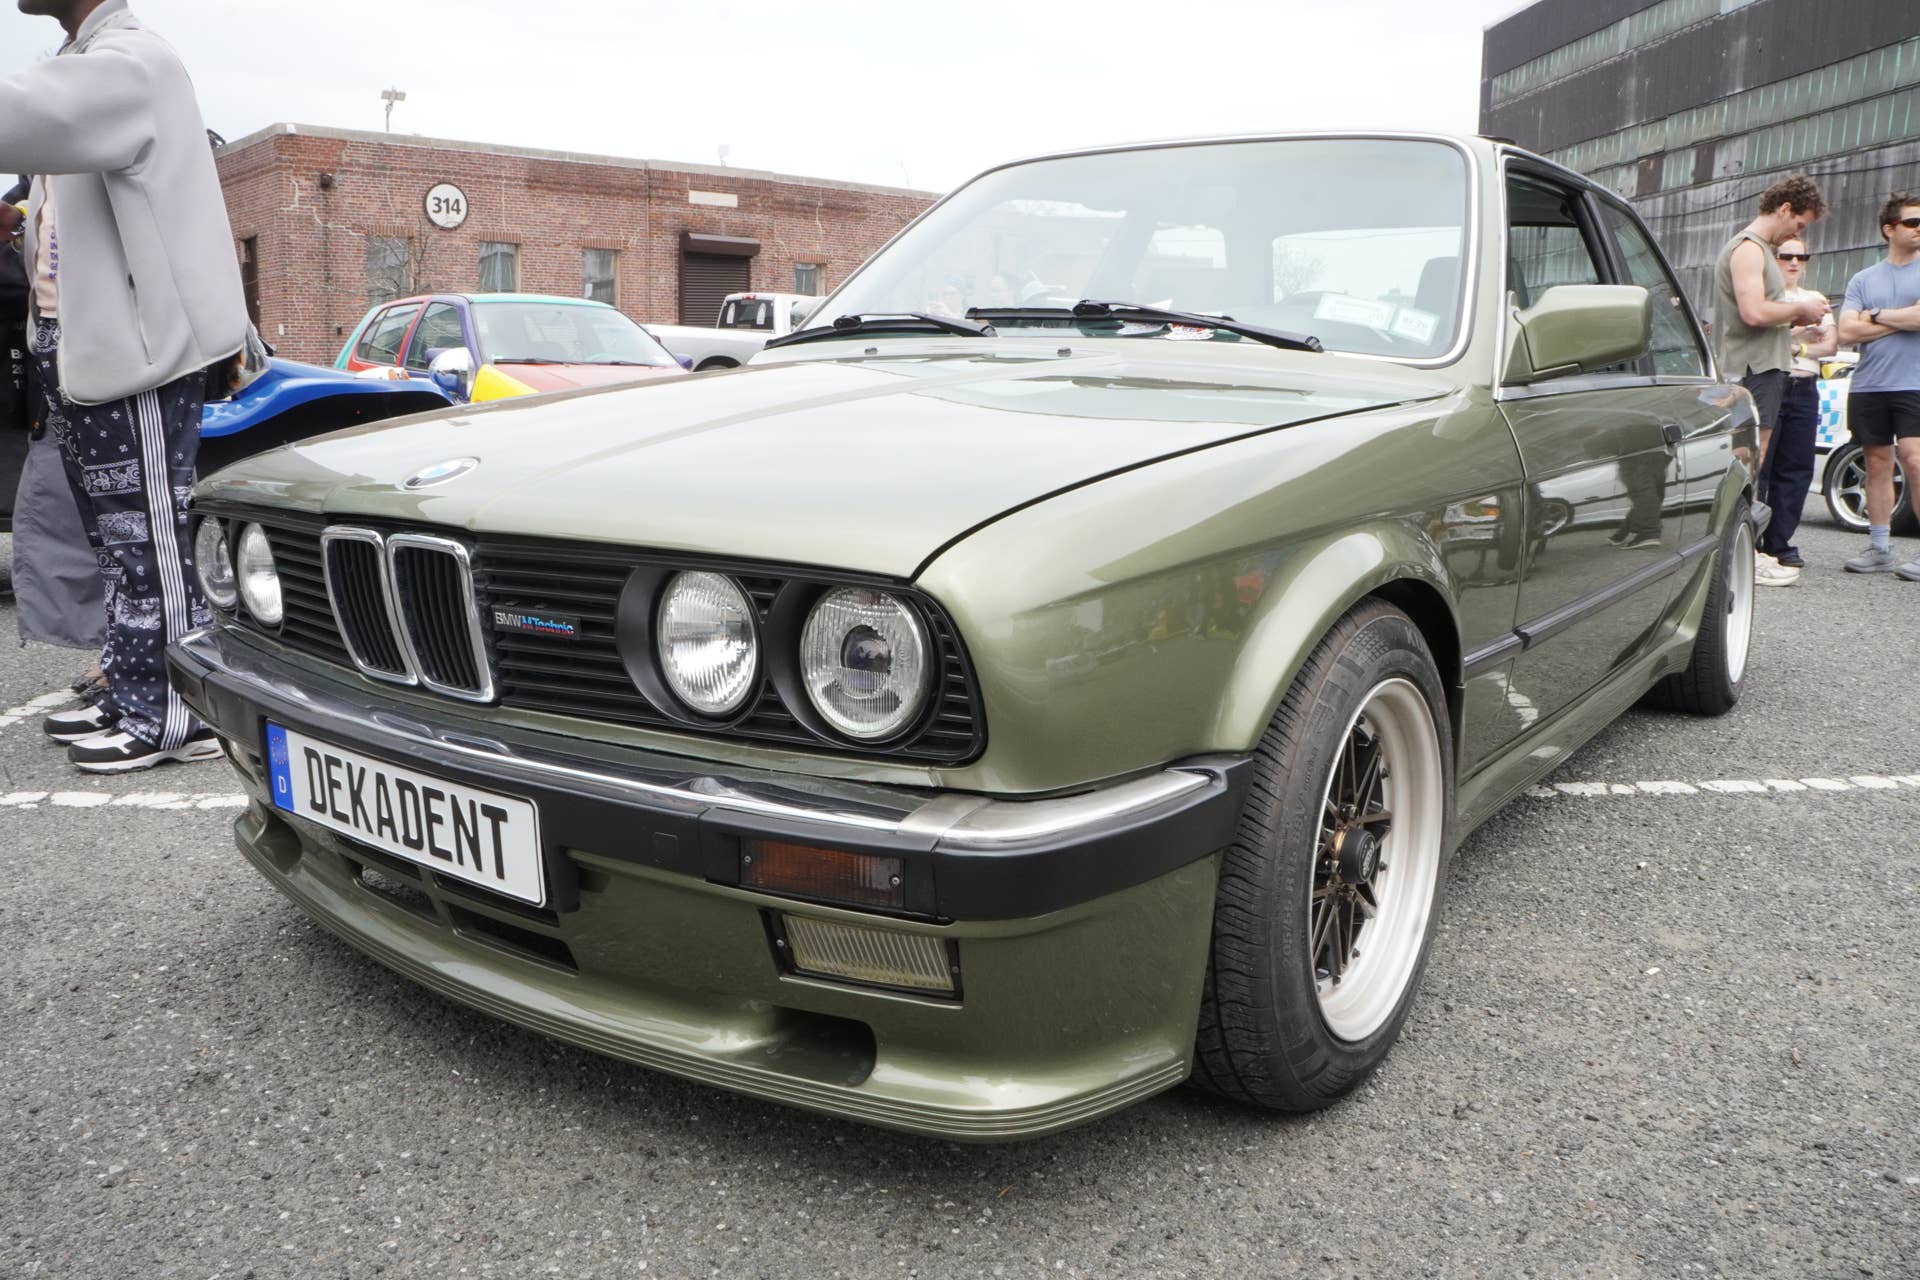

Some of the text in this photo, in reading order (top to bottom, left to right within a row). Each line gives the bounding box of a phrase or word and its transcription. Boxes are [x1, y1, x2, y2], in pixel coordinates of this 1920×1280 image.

[432, 196, 461, 215] 314
[495, 611, 521, 628] BMW
[278, 775, 287, 794] D
[303, 746, 508, 881] DEKADENT
